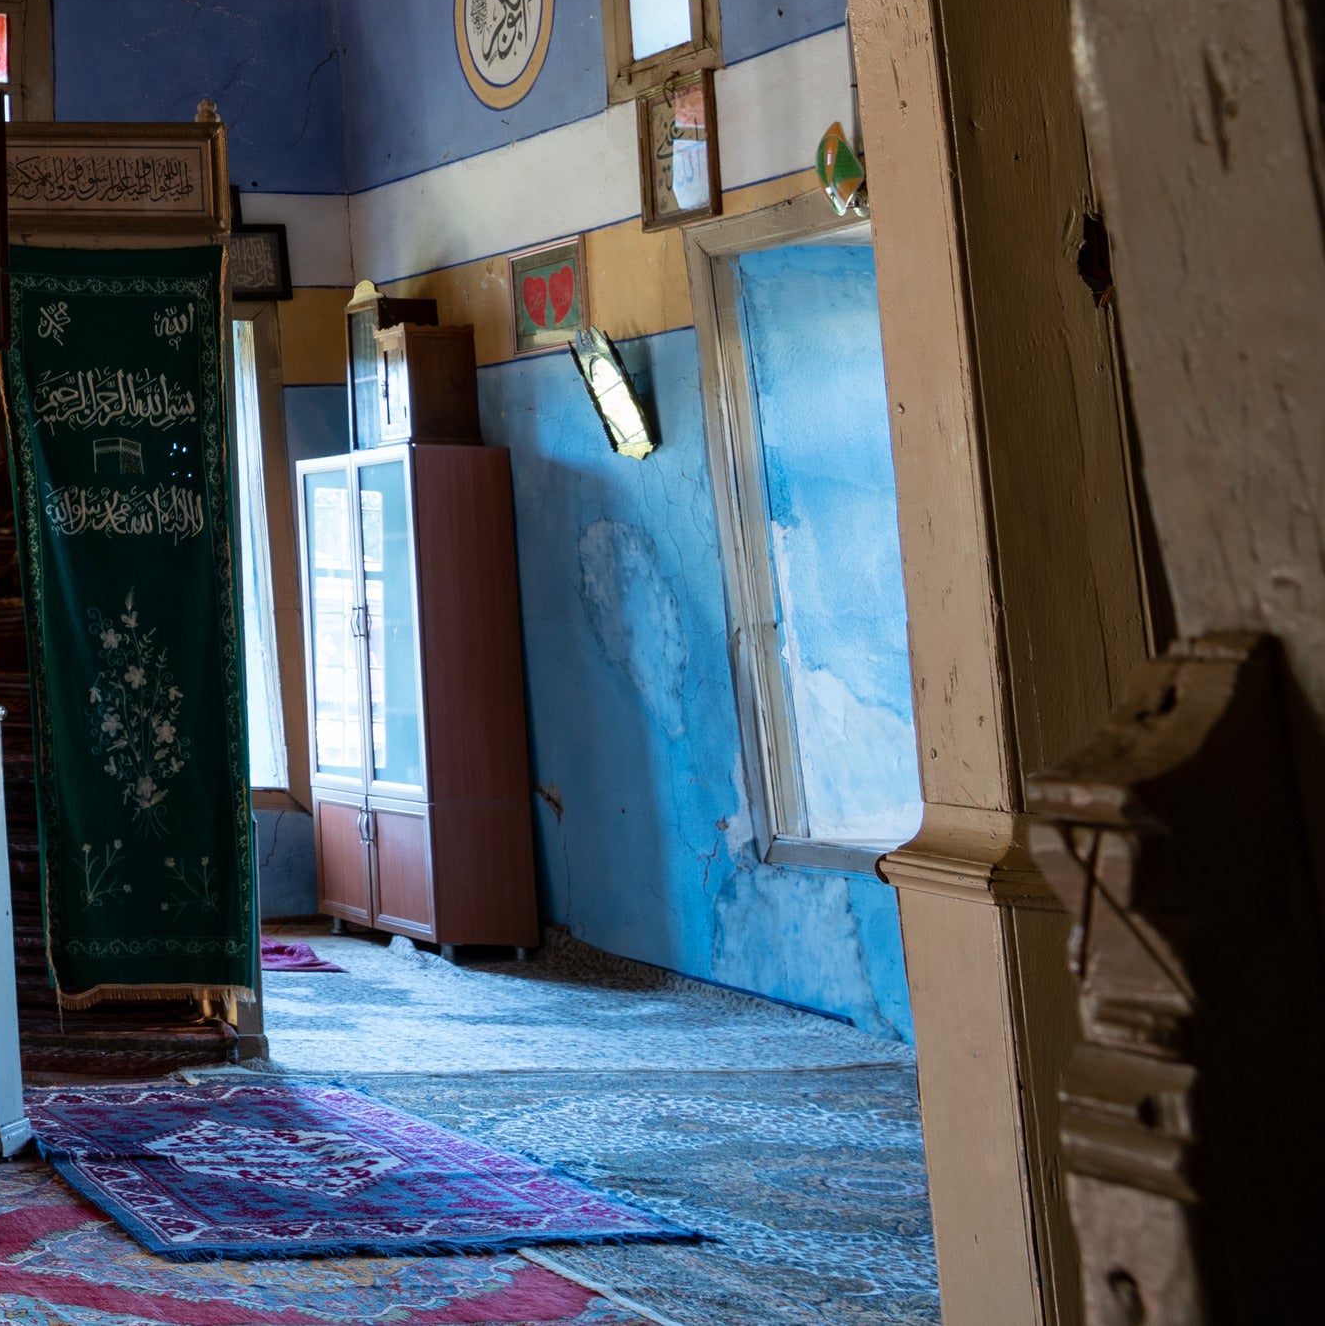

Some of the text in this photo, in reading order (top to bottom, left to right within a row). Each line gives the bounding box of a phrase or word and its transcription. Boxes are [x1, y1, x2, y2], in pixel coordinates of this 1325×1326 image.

[37, 300, 71, 340] محمد
[154, 302, 194, 340] الله
[33, 370, 96, 423] الرحيم
